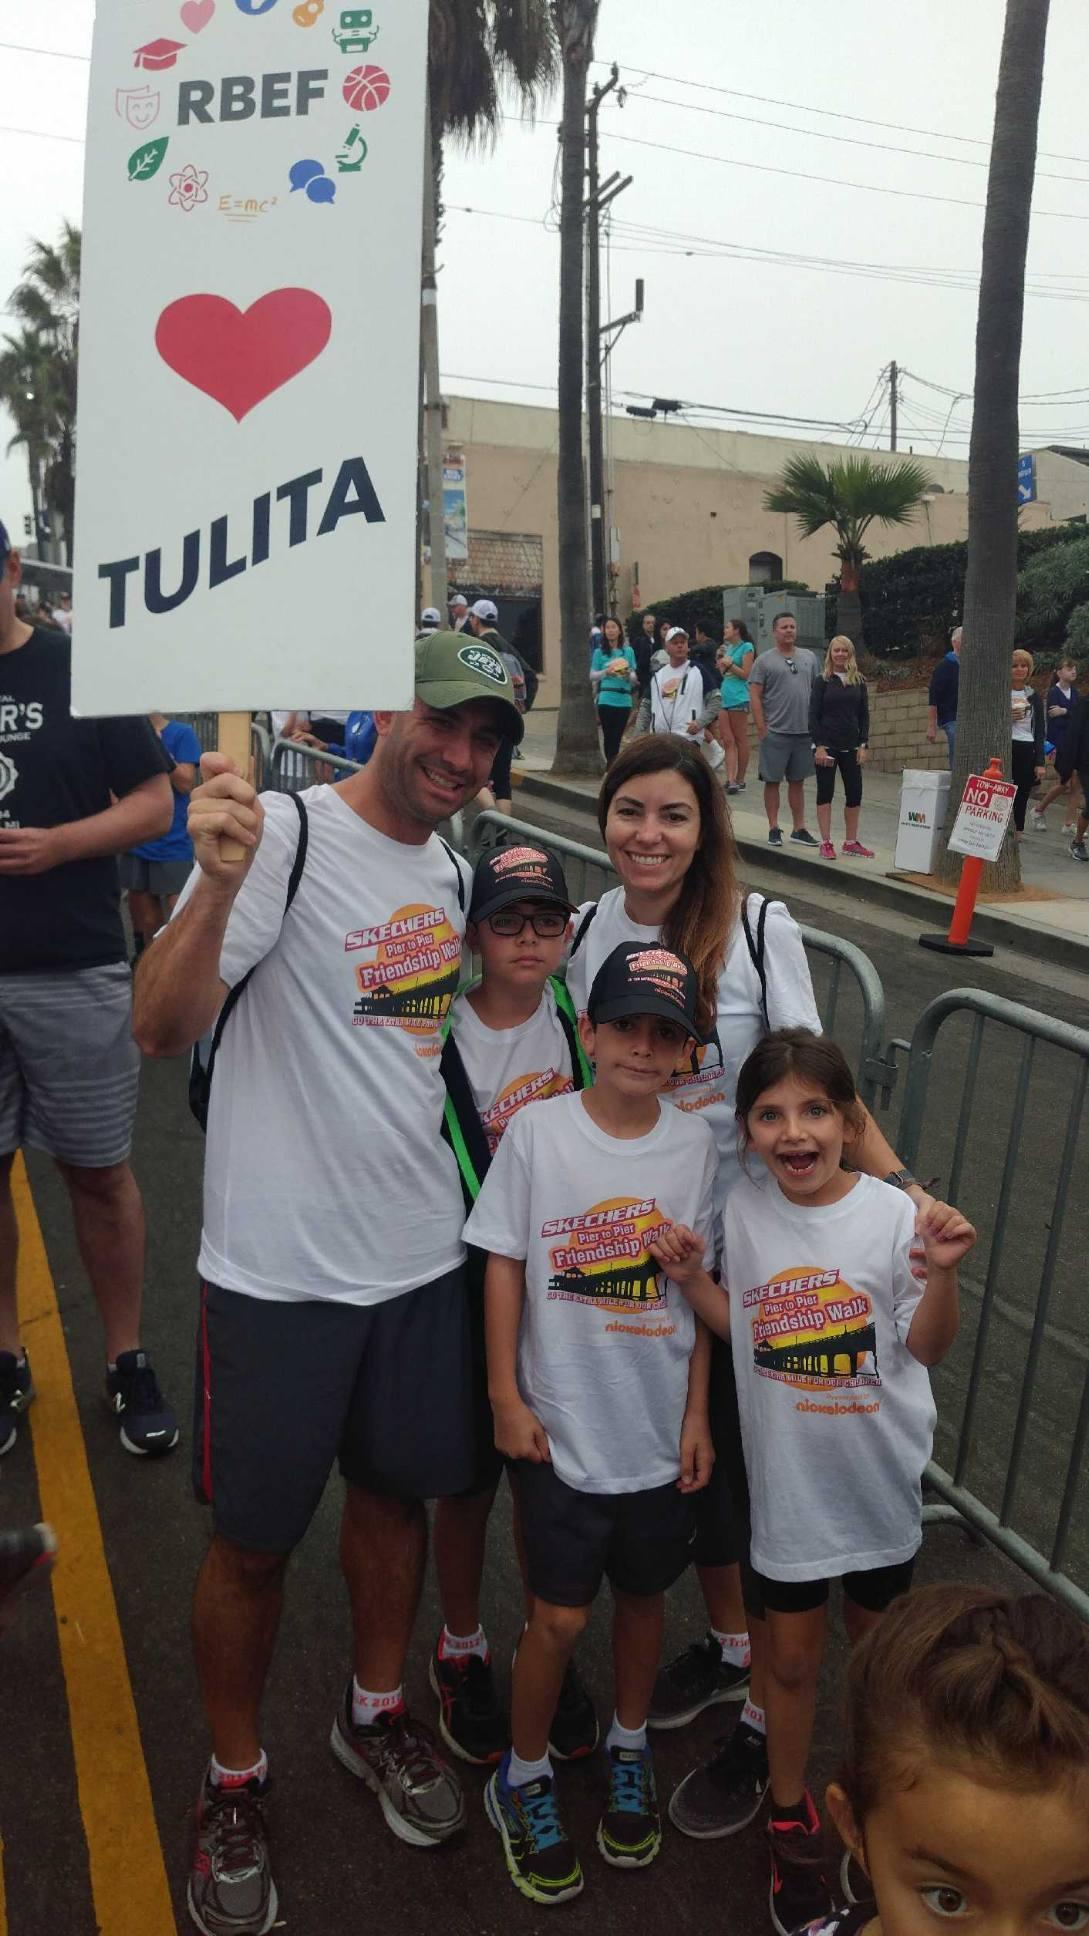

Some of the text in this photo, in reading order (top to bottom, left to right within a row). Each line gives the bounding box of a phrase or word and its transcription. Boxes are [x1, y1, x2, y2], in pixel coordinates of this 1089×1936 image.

[177, 69, 329, 126] RBEF
[98, 456, 386, 628] TULITA
[965, 805, 1003, 823] PARKING
[966, 788, 989, 806] NO
[345, 907, 445, 952] SKECHERS
[386, 933, 434, 958] Pier to Pier
[361, 949, 441, 989] Friendship
[480, 1066, 555, 1125] KECHERS
[541, 1198, 656, 1238] SKECHERS
[577, 1223, 636, 1245] Pier to Pier
[553, 1237, 641, 1269] Friendship
[743, 1269, 840, 1308] SKECHERS
[763, 1294, 818, 1316] Pier to Pier
[752, 1295, 869, 1340] Friendship Walk
[795, 1398, 880, 1416] nickelodeon
